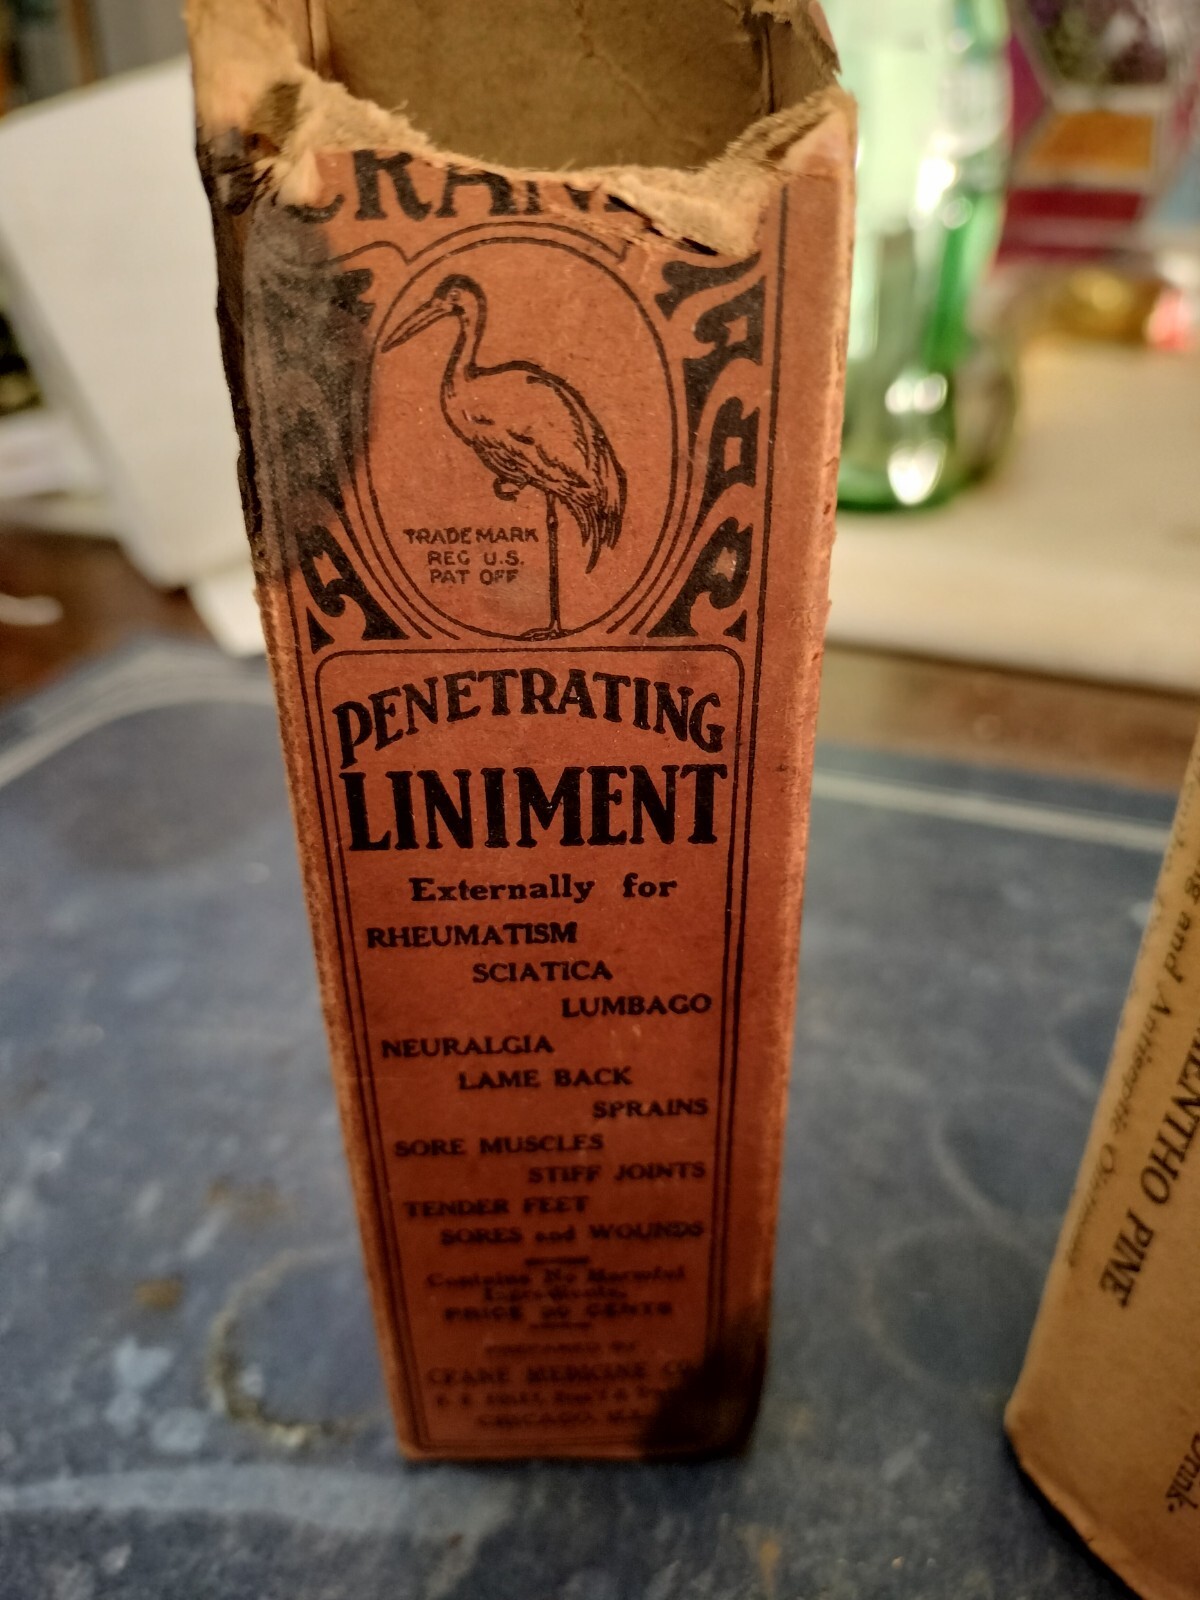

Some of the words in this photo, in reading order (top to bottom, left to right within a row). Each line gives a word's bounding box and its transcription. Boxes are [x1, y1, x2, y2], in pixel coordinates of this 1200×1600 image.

[403, 527, 472, 545] TRADE
[475, 526, 539, 544] MARK
[483, 550, 525, 566] U.S.
[430, 568, 471, 585] PAT
[331, 667, 725, 769] PENETRATING
[339, 763, 728, 851] LINIMENT
[410, 873, 595, 903] Externally
[622, 872, 678, 898] for
[366, 921, 578, 949] RHEUMATISM
[1164, 911, 1191, 984] and
[472, 960, 614, 983] SCIATICA
[561, 993, 712, 1019] LUMBAGO
[381, 1034, 555, 1059] NEURALGIA
[458, 1068, 540, 1091] LAME
[554, 1066, 632, 1088] BACK
[592, 1097, 708, 1120] SPRAINS
[1141, 1028, 1200, 1204] ENTHO
[395, 1138, 465, 1158] SORE
[479, 1133, 604, 1155] MUSCLES
[528, 1165, 600, 1184] STIFF
[614, 1161, 706, 1182] JOINTS
[403, 1200, 510, 1218] TENDER
[522, 1195, 590, 1214] FEET
[439, 1227, 523, 1246] SORES
[535, 1225, 576, 1243] and
[587, 1220, 704, 1241] WOUNDS
[1099, 1207, 1154, 1309] PINE
